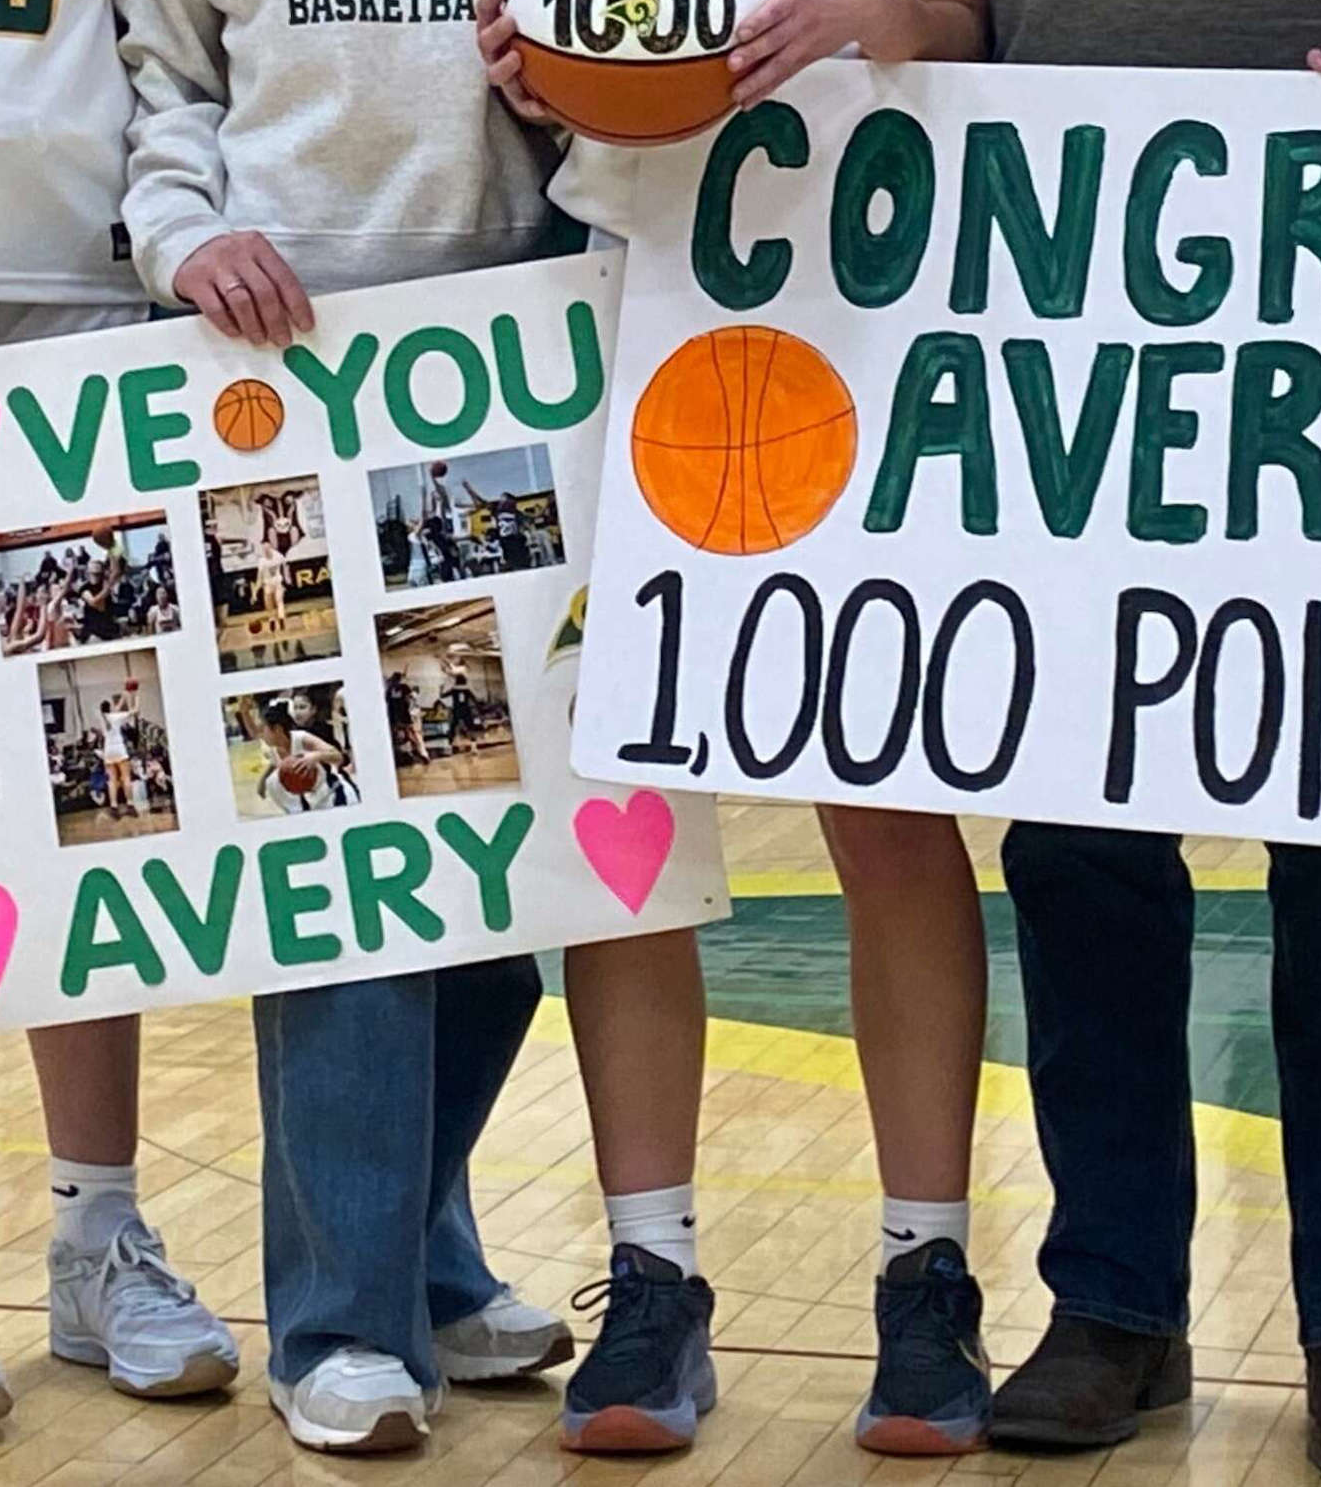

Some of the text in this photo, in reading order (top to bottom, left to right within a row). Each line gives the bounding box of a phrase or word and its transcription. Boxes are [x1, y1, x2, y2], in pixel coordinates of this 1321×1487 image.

[283, 299, 606, 461] YOU
[616, 569, 1036, 793] 1,000
[58, 800, 537, 1000] AVERY
